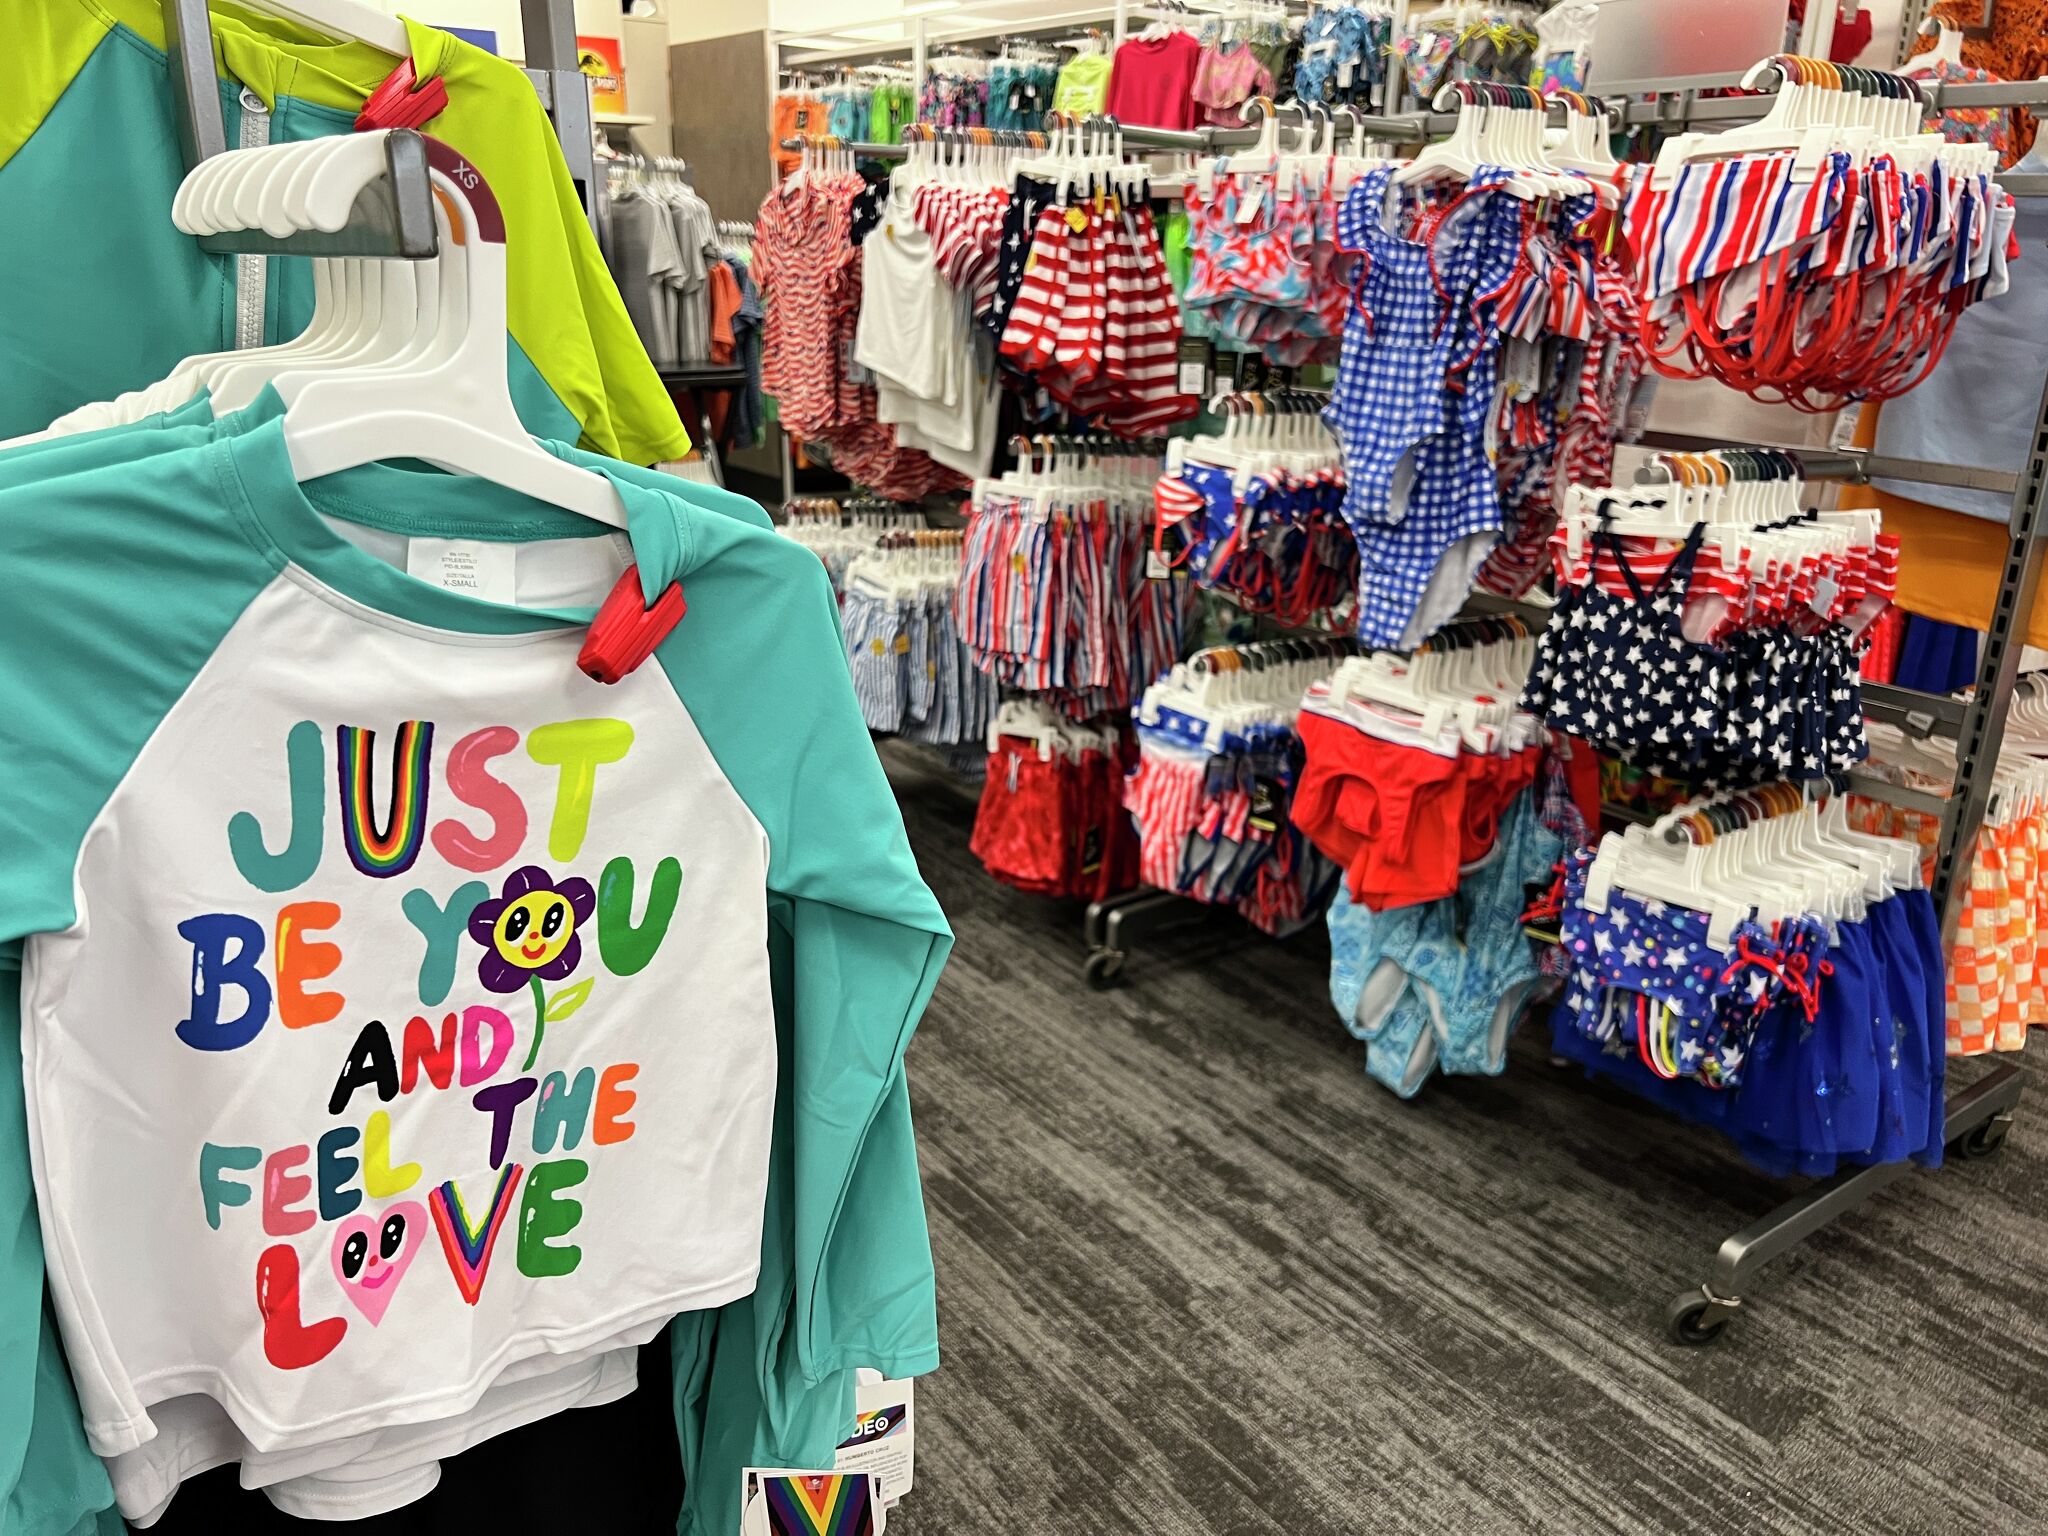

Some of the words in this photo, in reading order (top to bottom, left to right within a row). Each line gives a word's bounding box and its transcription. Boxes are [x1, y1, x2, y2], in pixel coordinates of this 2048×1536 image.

[451, 160, 479, 190] XS
[443, 579, 479, 588] X-SMALL
[228, 717, 634, 893] JUST
[175, 901, 346, 1051] BE
[328, 1005, 515, 1115] AND
[199, 1110, 422, 1236] FEEL
[472, 1063, 640, 1170] THE
